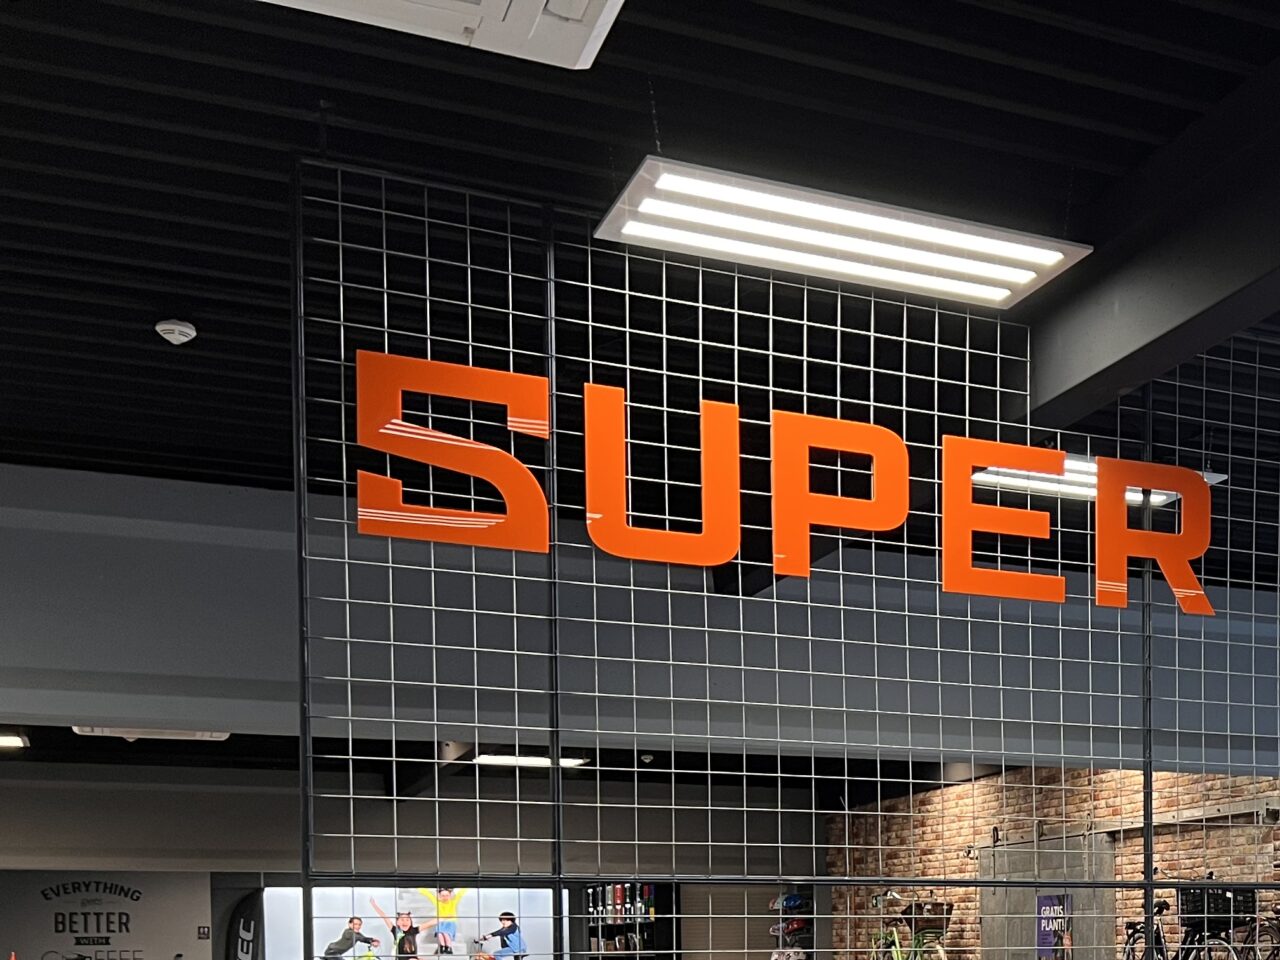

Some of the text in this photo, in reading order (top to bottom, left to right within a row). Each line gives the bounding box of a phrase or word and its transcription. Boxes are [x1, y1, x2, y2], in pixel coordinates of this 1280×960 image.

[356, 349, 1215, 615] SUPER
[41, 881, 142, 902] EVERYTHING
[1041, 906, 1063, 917] GRATIS
[54, 912, 130, 934] BETTER
[1041, 919, 1064, 931] PLANT!
